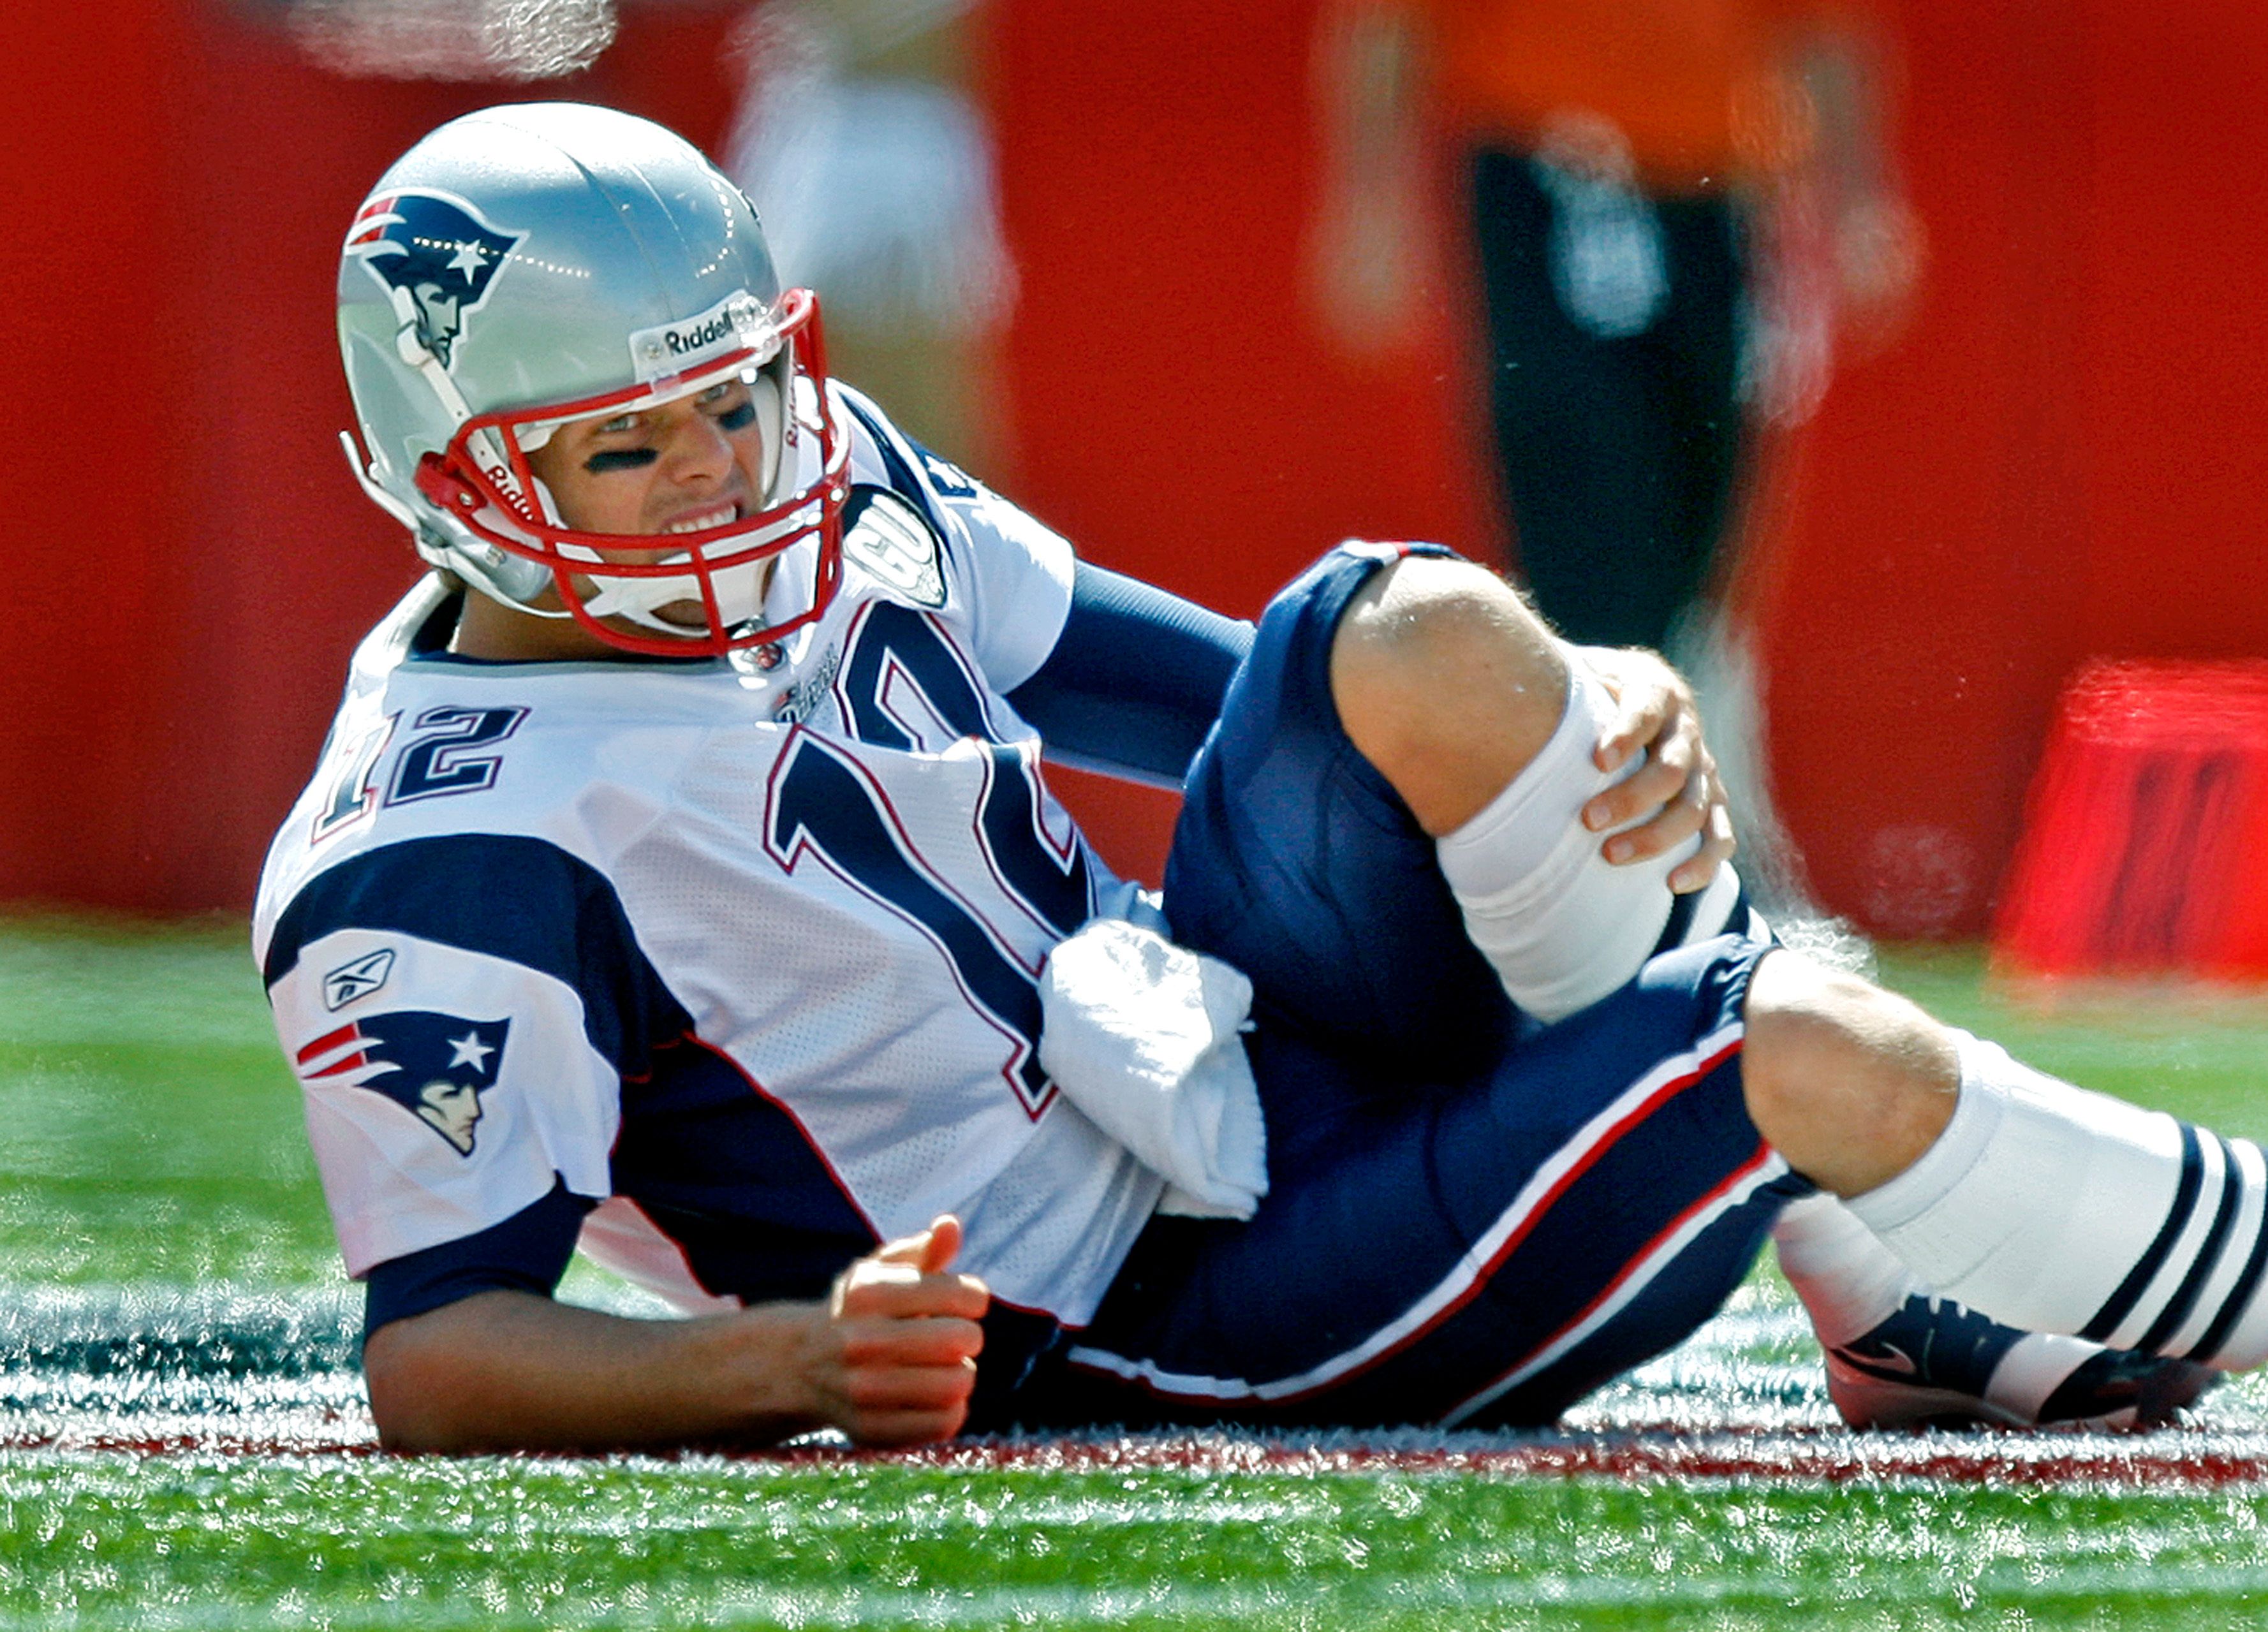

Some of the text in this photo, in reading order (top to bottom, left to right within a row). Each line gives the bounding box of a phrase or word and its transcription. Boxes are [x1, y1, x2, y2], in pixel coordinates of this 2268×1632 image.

[665, 304, 733, 355] Riddell
[310, 705, 532, 845] 12
[763, 597, 1098, 1122] 12
